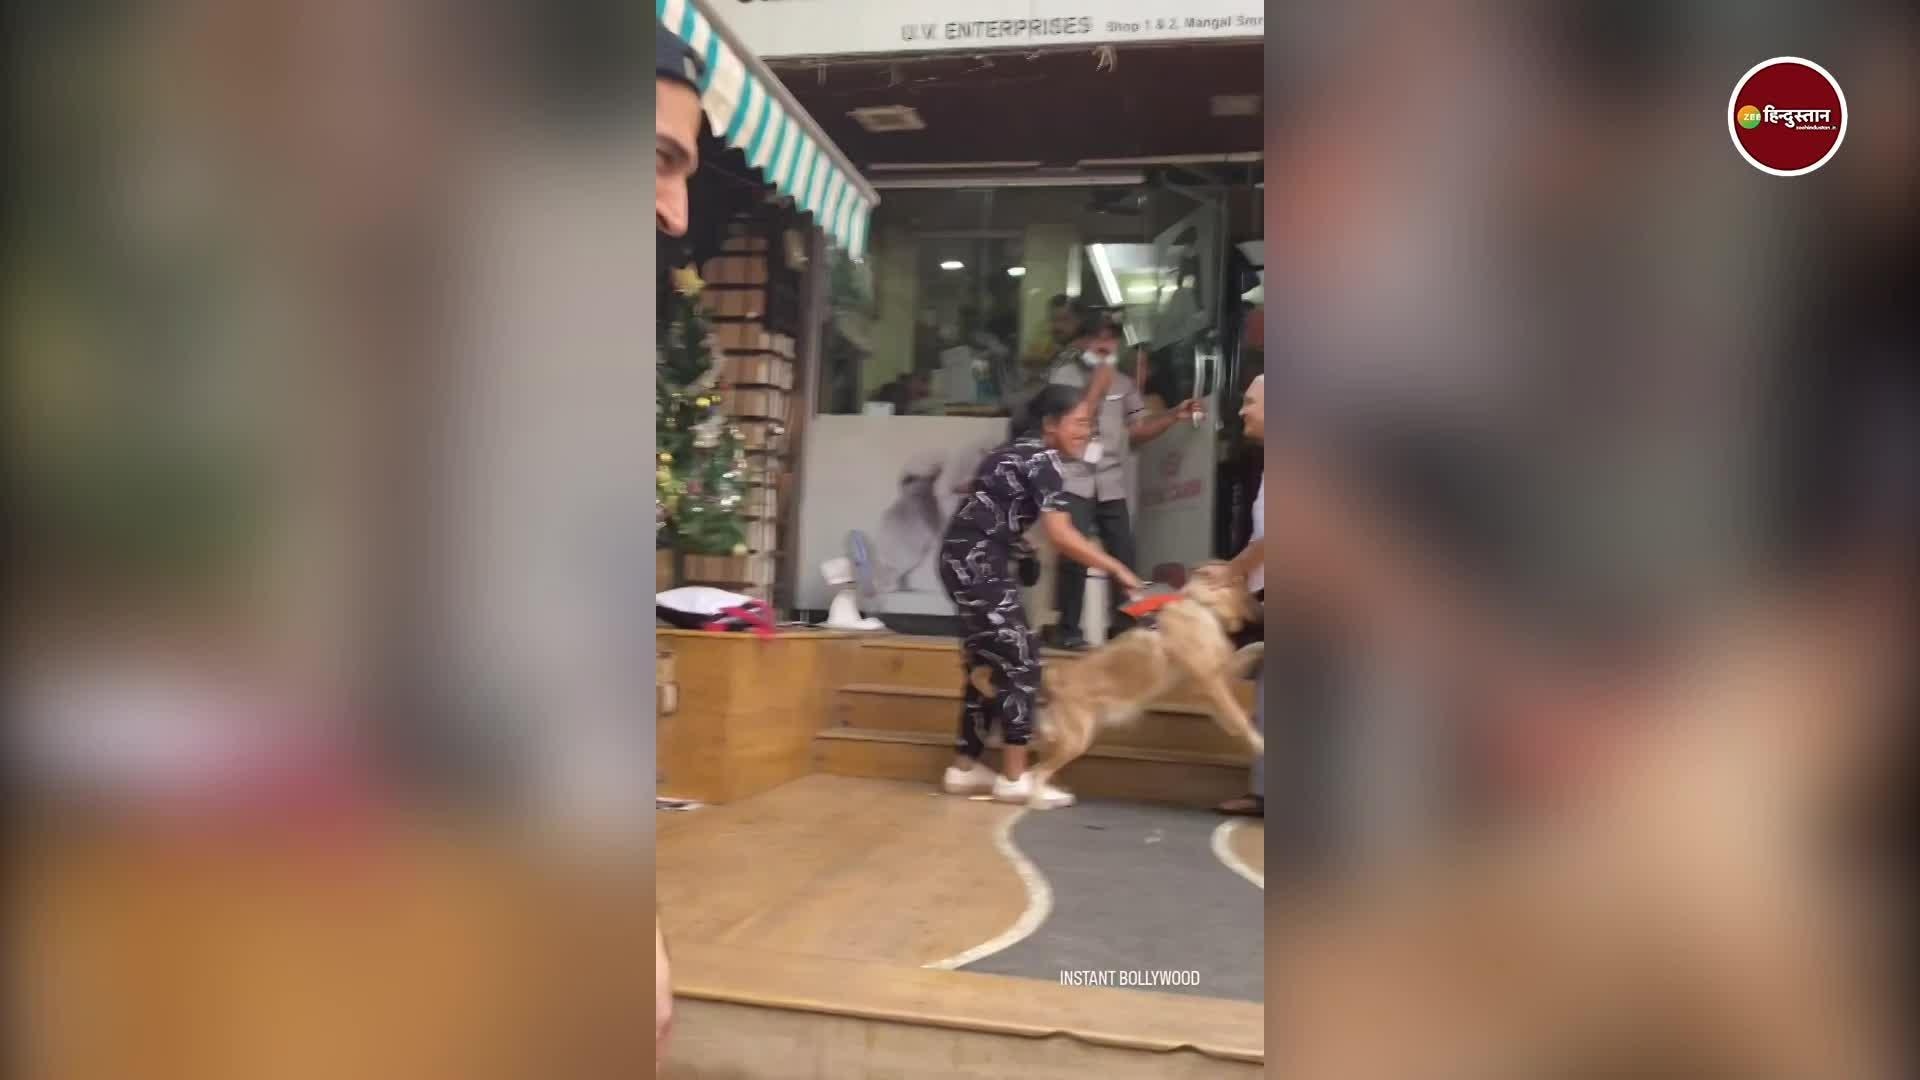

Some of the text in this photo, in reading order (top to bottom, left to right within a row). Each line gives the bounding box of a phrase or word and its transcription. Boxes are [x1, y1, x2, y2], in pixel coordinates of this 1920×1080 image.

[945, 16, 1092, 40] ENTERPRISES
[1105, 21, 1139, 33] Shop
[1155, 18, 1165, 30] &
[1184, 16, 1231, 29] Mangal
